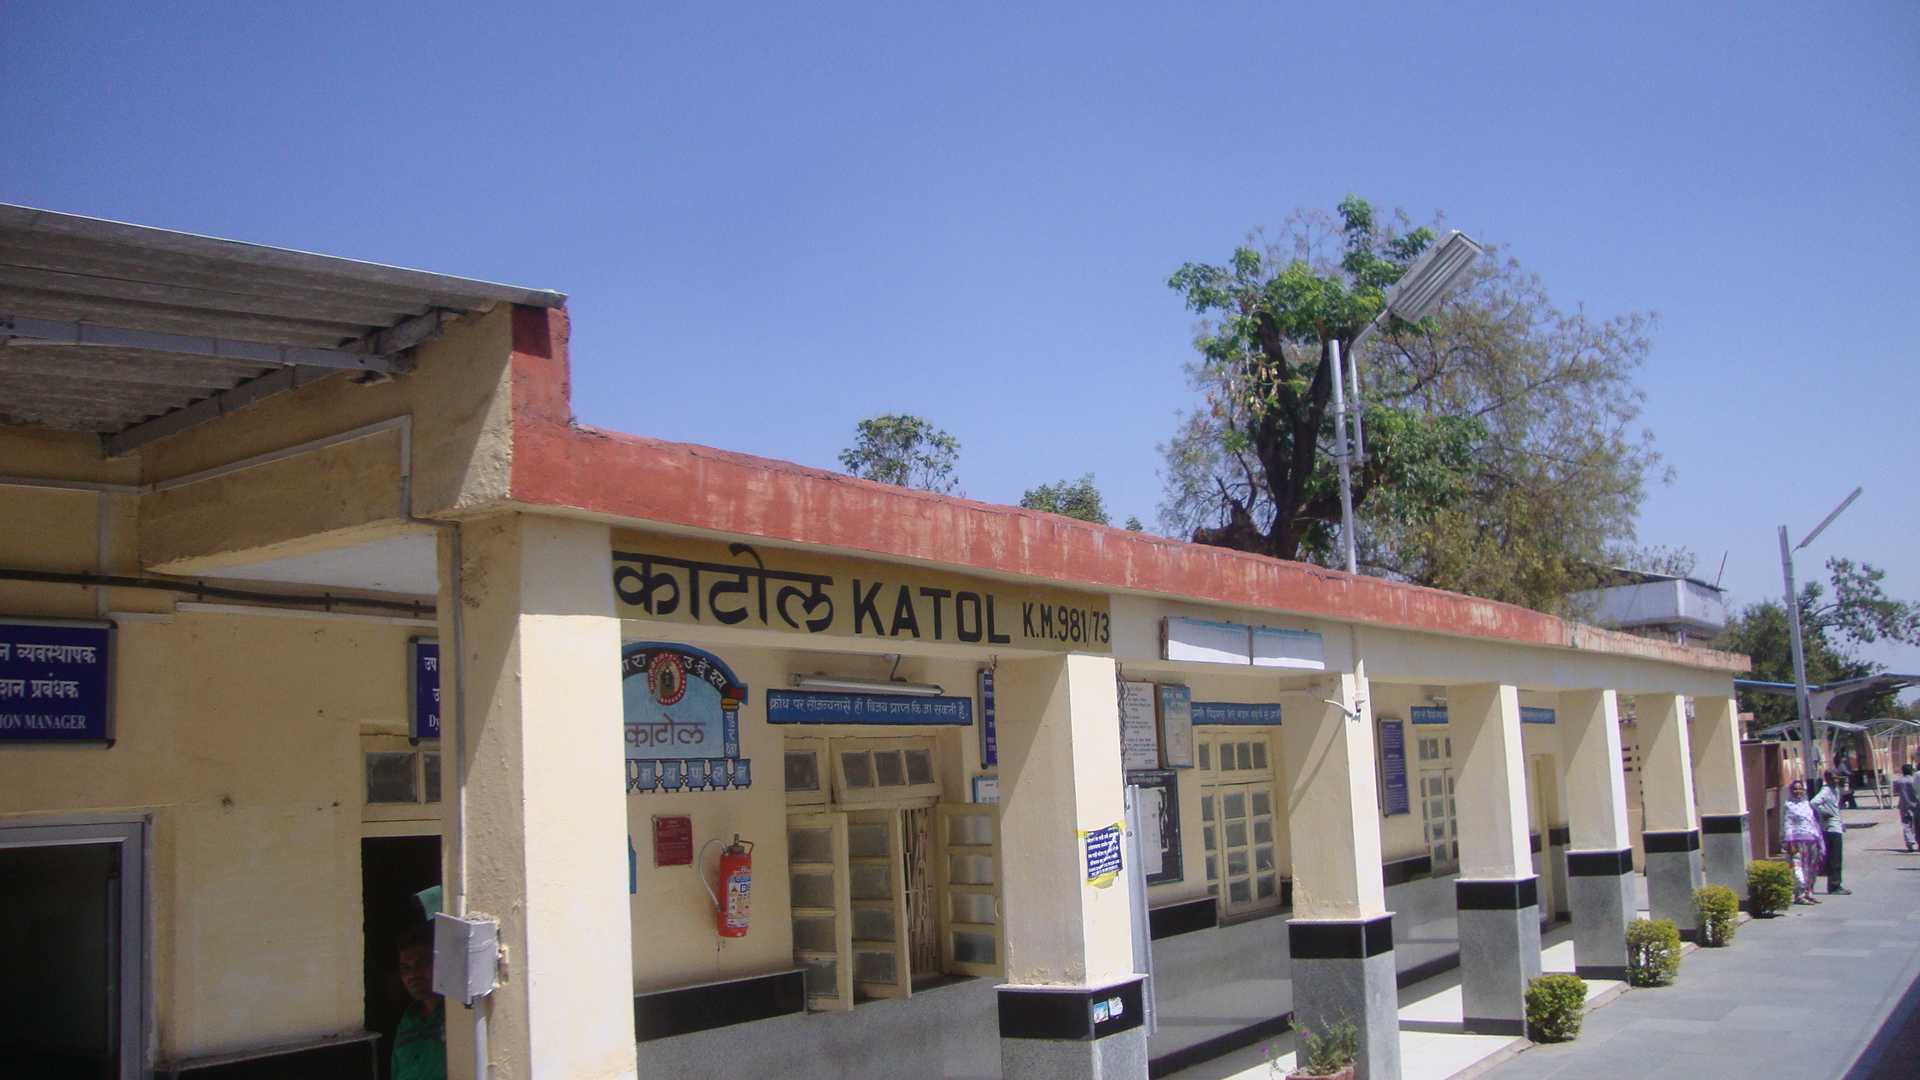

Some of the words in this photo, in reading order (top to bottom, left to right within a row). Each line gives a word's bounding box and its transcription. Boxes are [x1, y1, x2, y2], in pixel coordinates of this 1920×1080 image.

[612, 542, 834, 633] काटोल
[853, 578, 1010, 644] KATOL
[16, 643, 97, 664] व्यवस्थापक
[30, 671, 80, 698] प्रबंधक
[867, 698, 889, 713] विजय
[24, 714, 87, 730] MANAGER
